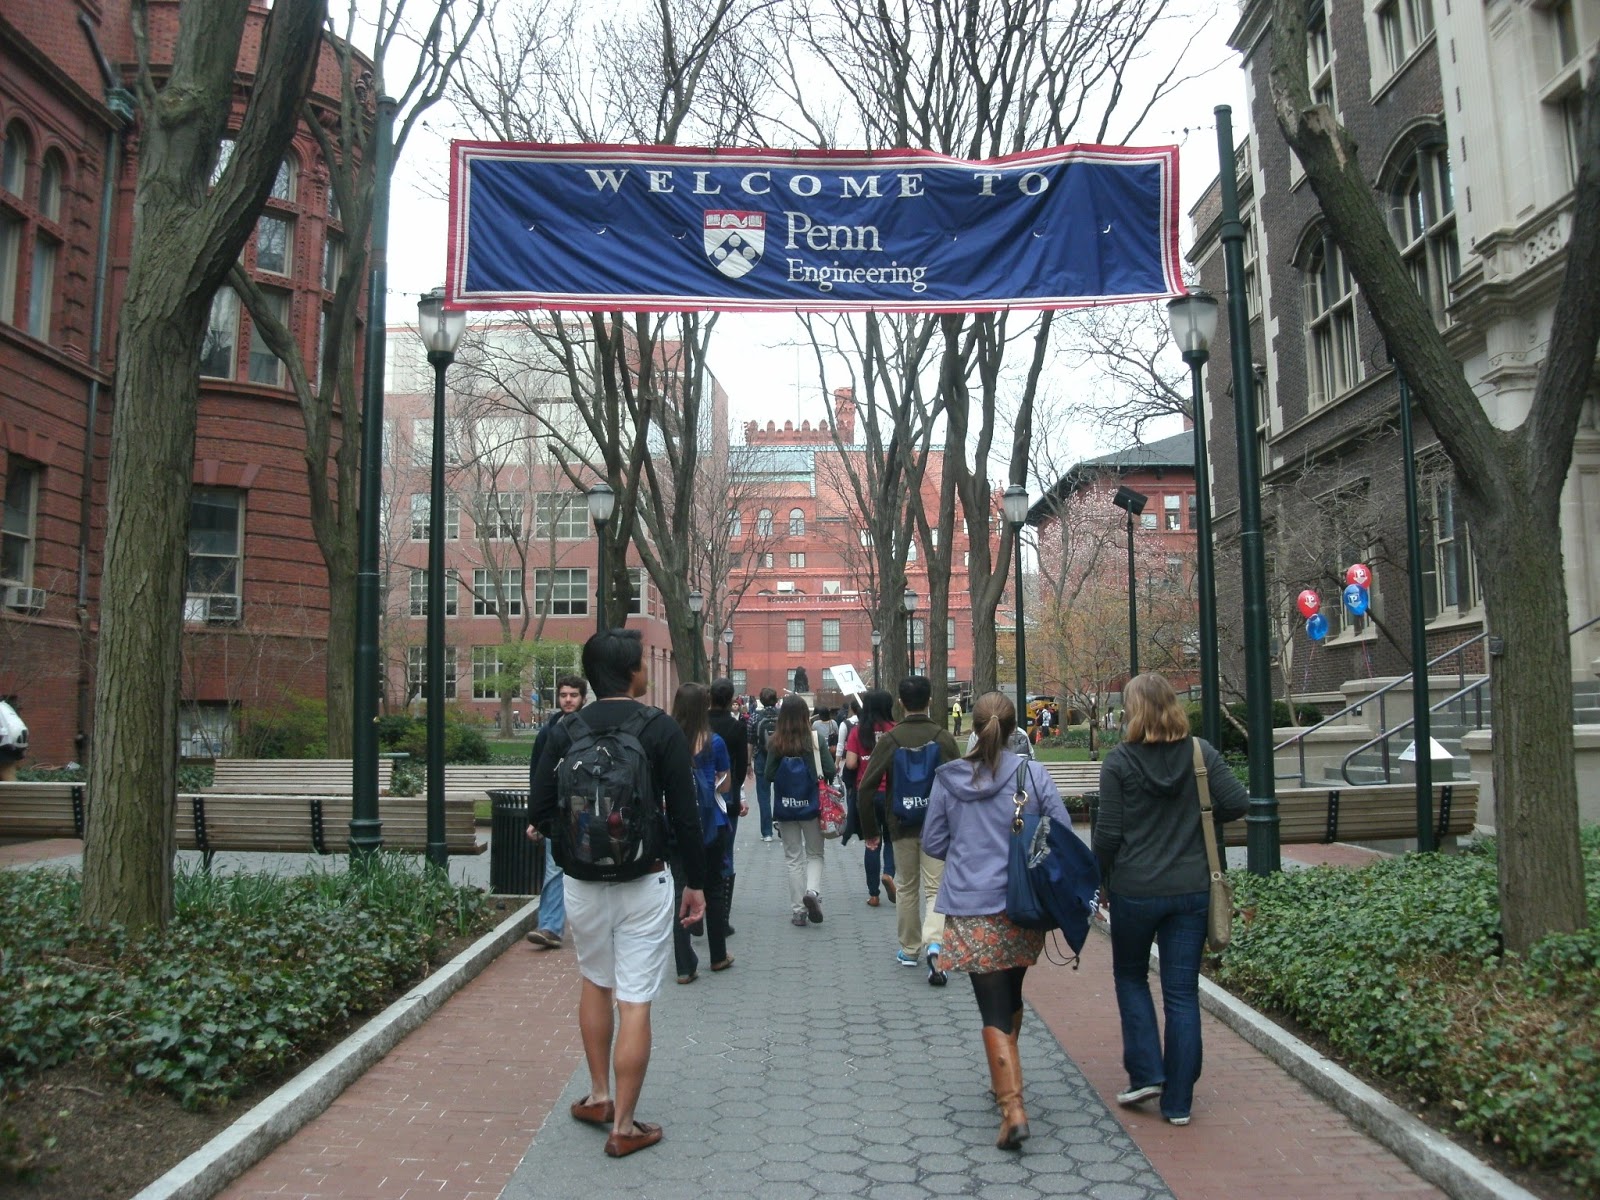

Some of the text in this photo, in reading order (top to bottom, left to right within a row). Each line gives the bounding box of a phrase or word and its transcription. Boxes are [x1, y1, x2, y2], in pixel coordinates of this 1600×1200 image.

[585, 168, 1051, 200] WELCOME TO
[783, 210, 883, 253] Penn
[787, 257, 928, 294] Engineering
[789, 797, 810, 808] Penn
